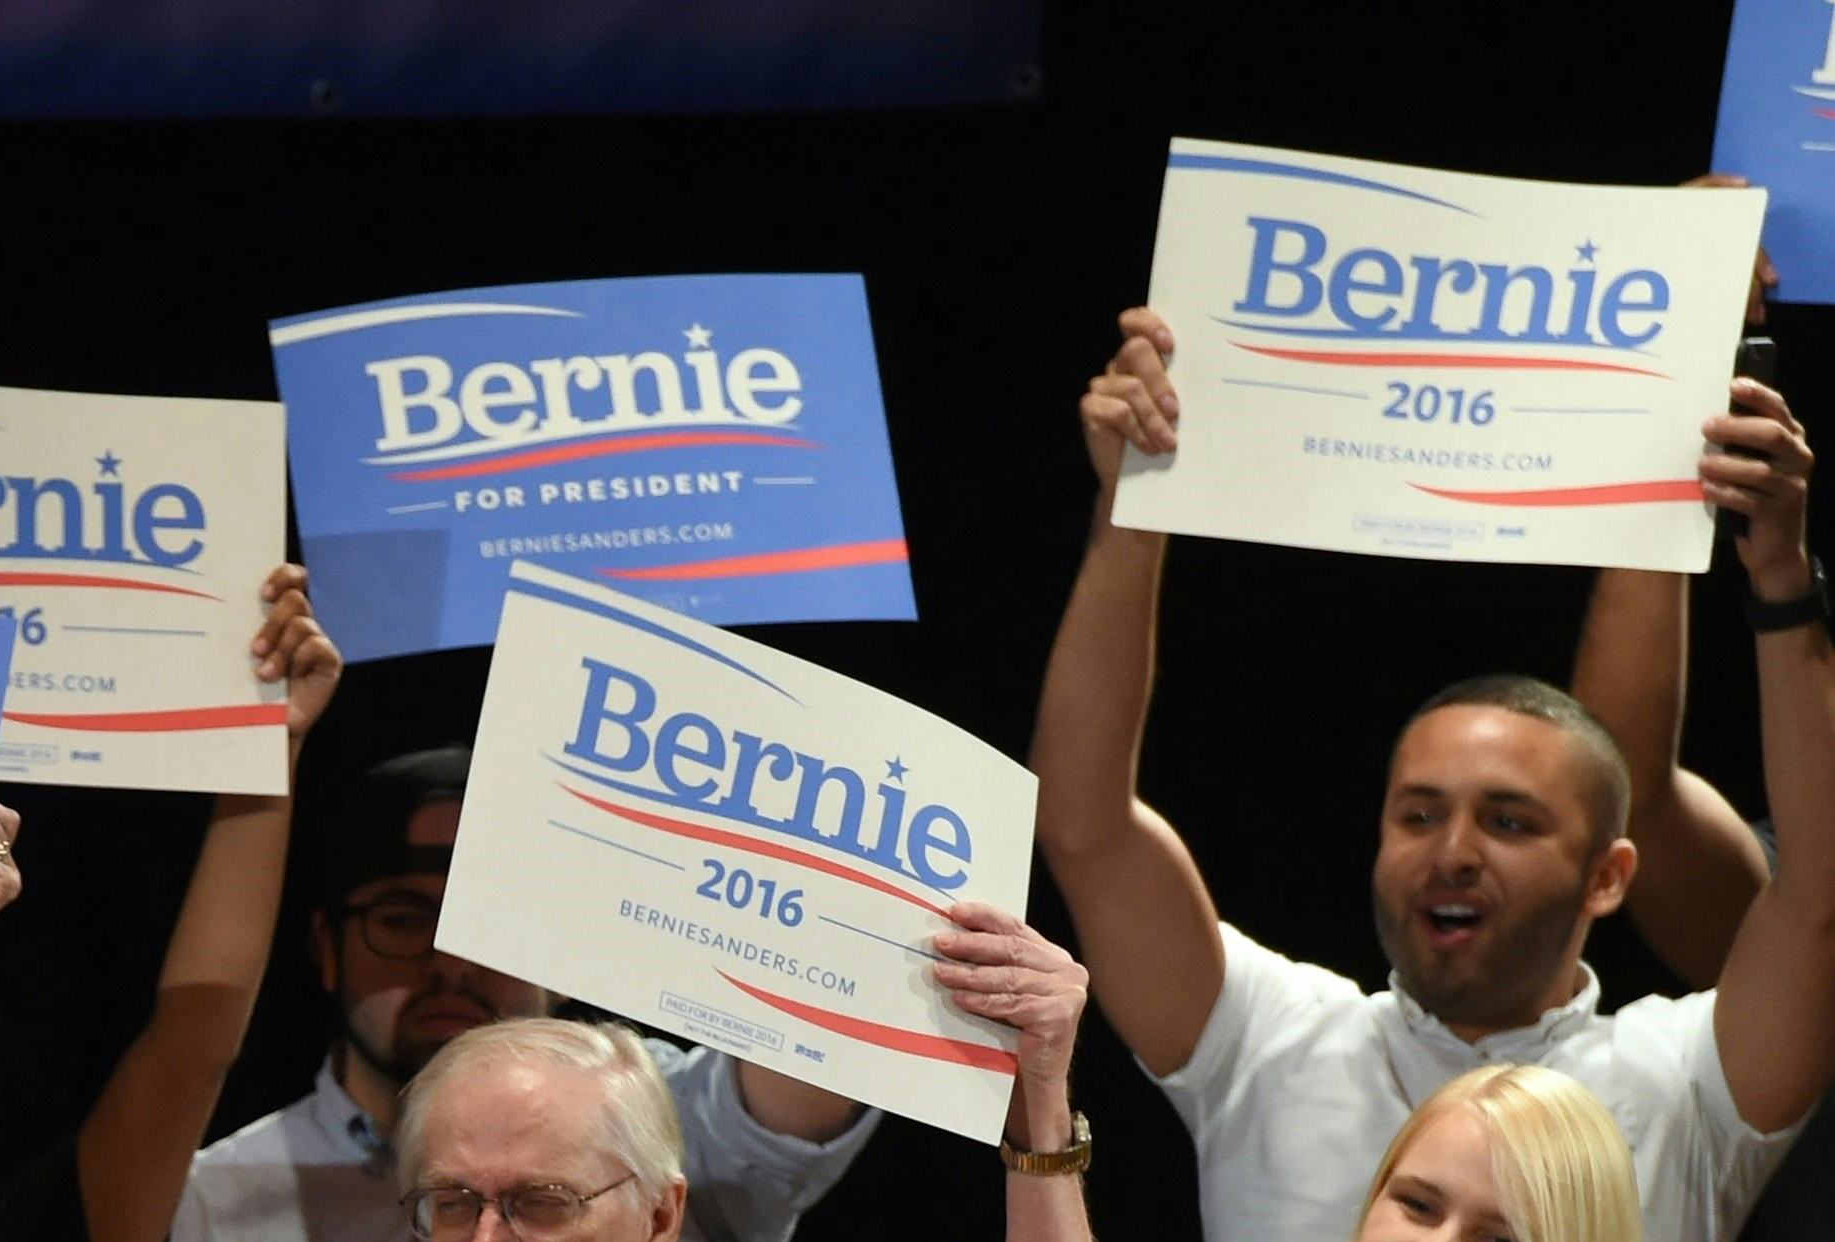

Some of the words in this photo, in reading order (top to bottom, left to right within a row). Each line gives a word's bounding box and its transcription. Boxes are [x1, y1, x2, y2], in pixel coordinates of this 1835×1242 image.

[1232, 214, 1671, 350] Bernie
[365, 322, 803, 452] Bernie
[1382, 380, 1495, 426] 2016
[1302, 436, 1553, 473] BERNIESANDERS.COM
[455, 485, 526, 512] FOR
[541, 471, 745, 505] PRESIDENT
[480, 522, 734, 560] BERNIESANDERS.COM
[564, 656, 973, 890] Bernie
[696, 859, 804, 928] 2016
[618, 899, 857, 999] BERNIESANDERS.COM
